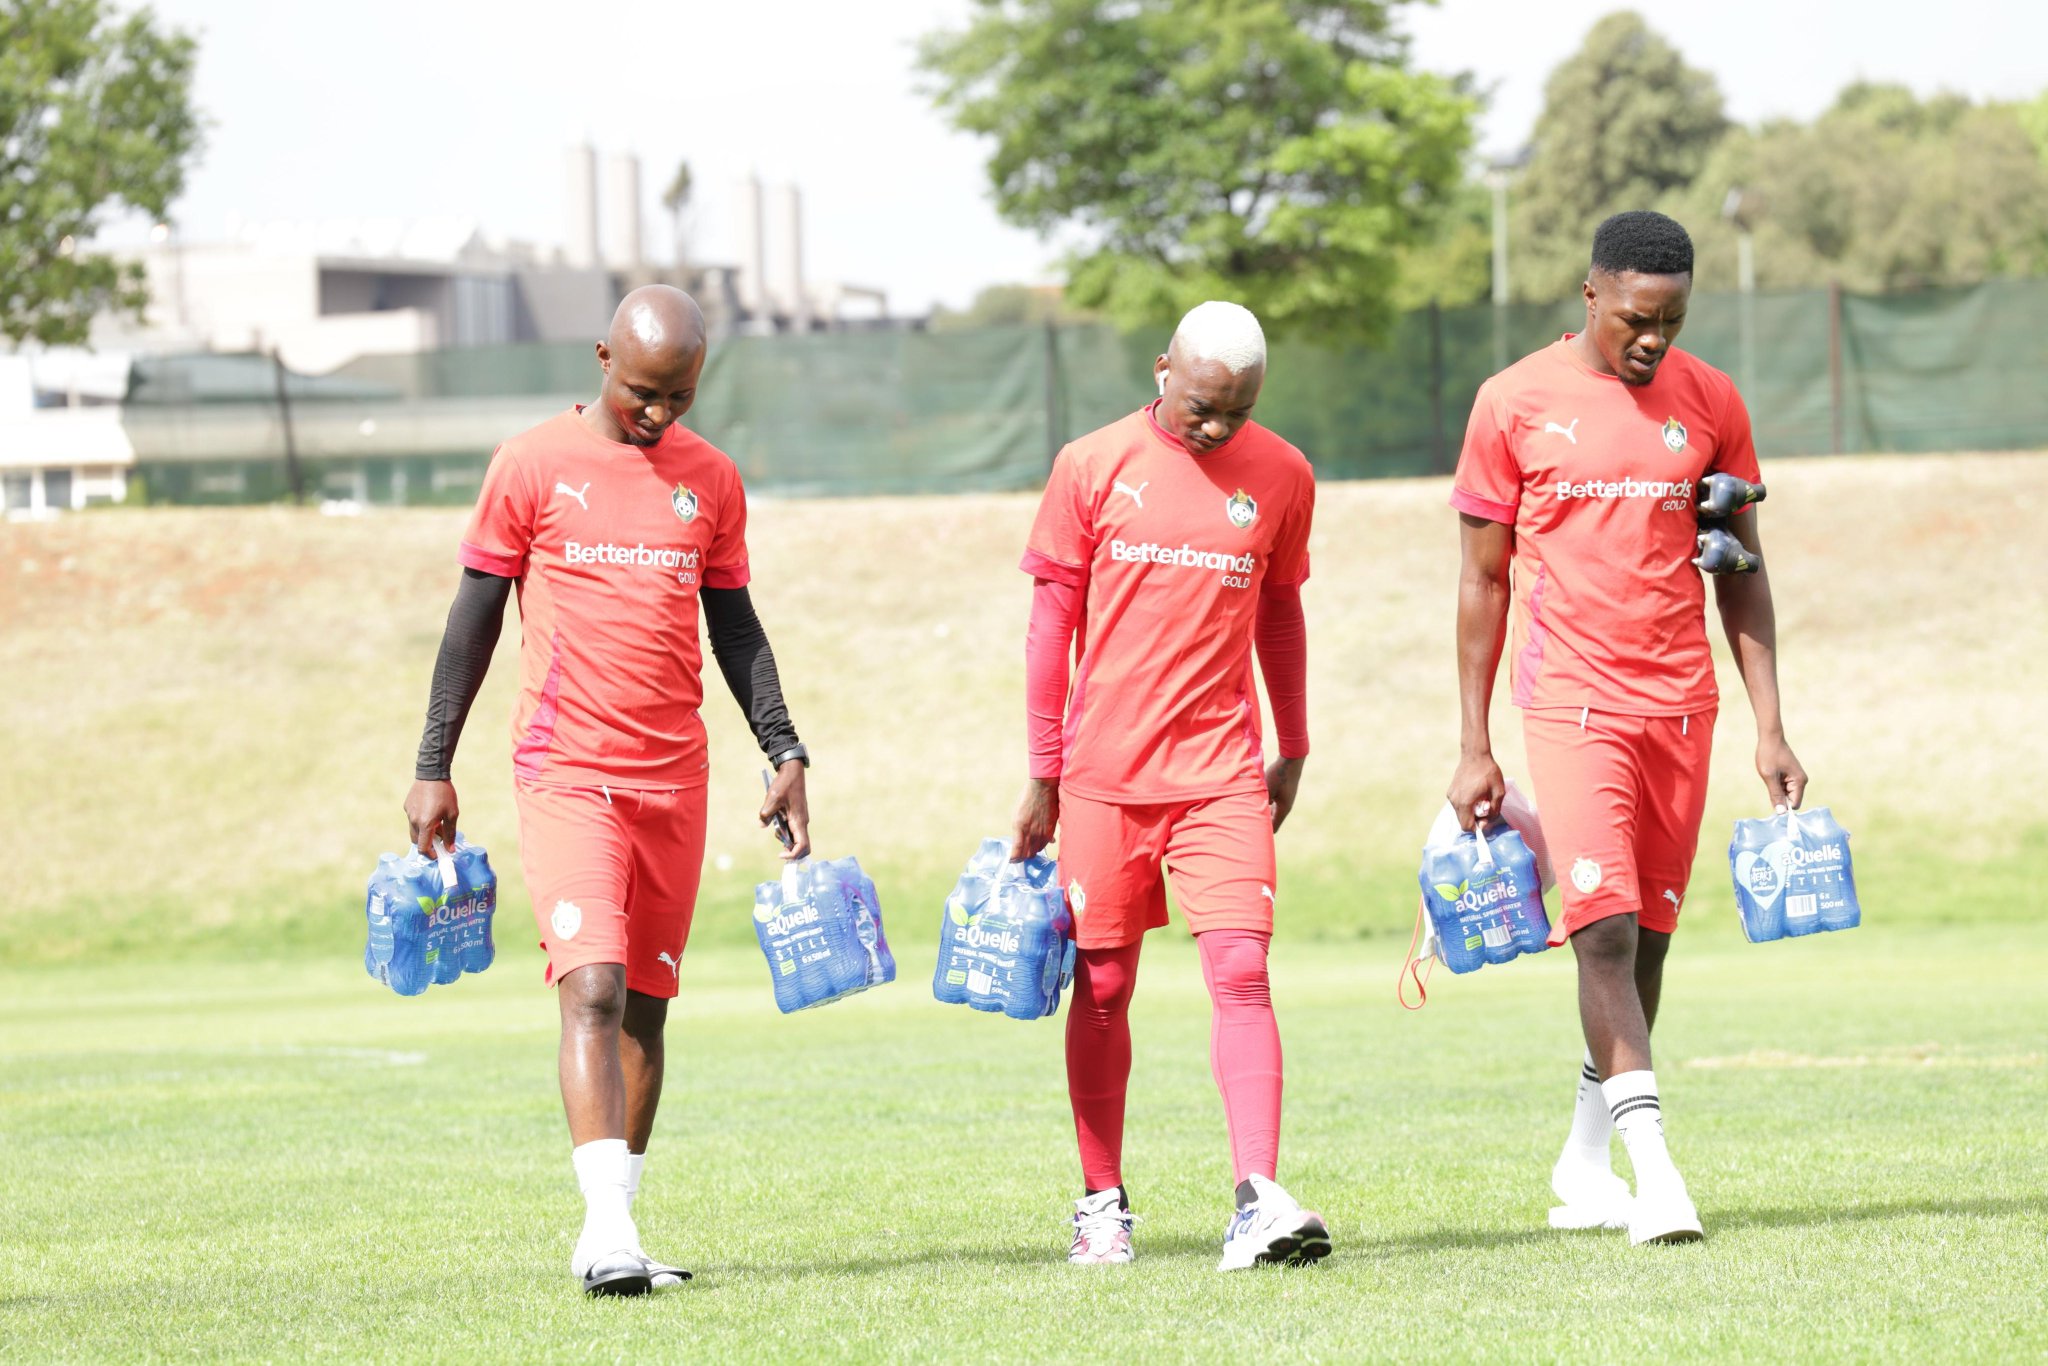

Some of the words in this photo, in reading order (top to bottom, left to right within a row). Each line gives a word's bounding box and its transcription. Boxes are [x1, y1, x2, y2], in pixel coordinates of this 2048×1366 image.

[1557, 476, 1693, 501] Betterbrands
[1662, 500, 1687, 511] GOLD
[1111, 540, 1256, 574] Betterbrands
[1221, 575, 1250, 588] GOLD
[1782, 843, 1841, 867] aQuellé
[1455, 880, 1518, 913] aQuellé
[428, 896, 488, 928] aQuellé
[766, 901, 819, 936] aQuellé
[1462, 910, 1525, 936] STILL
[426, 925, 484, 951] STILL
[775, 935, 828, 962] STILL
[954, 925, 1020, 954] aQuellé
[950, 955, 1013, 982] STILL
